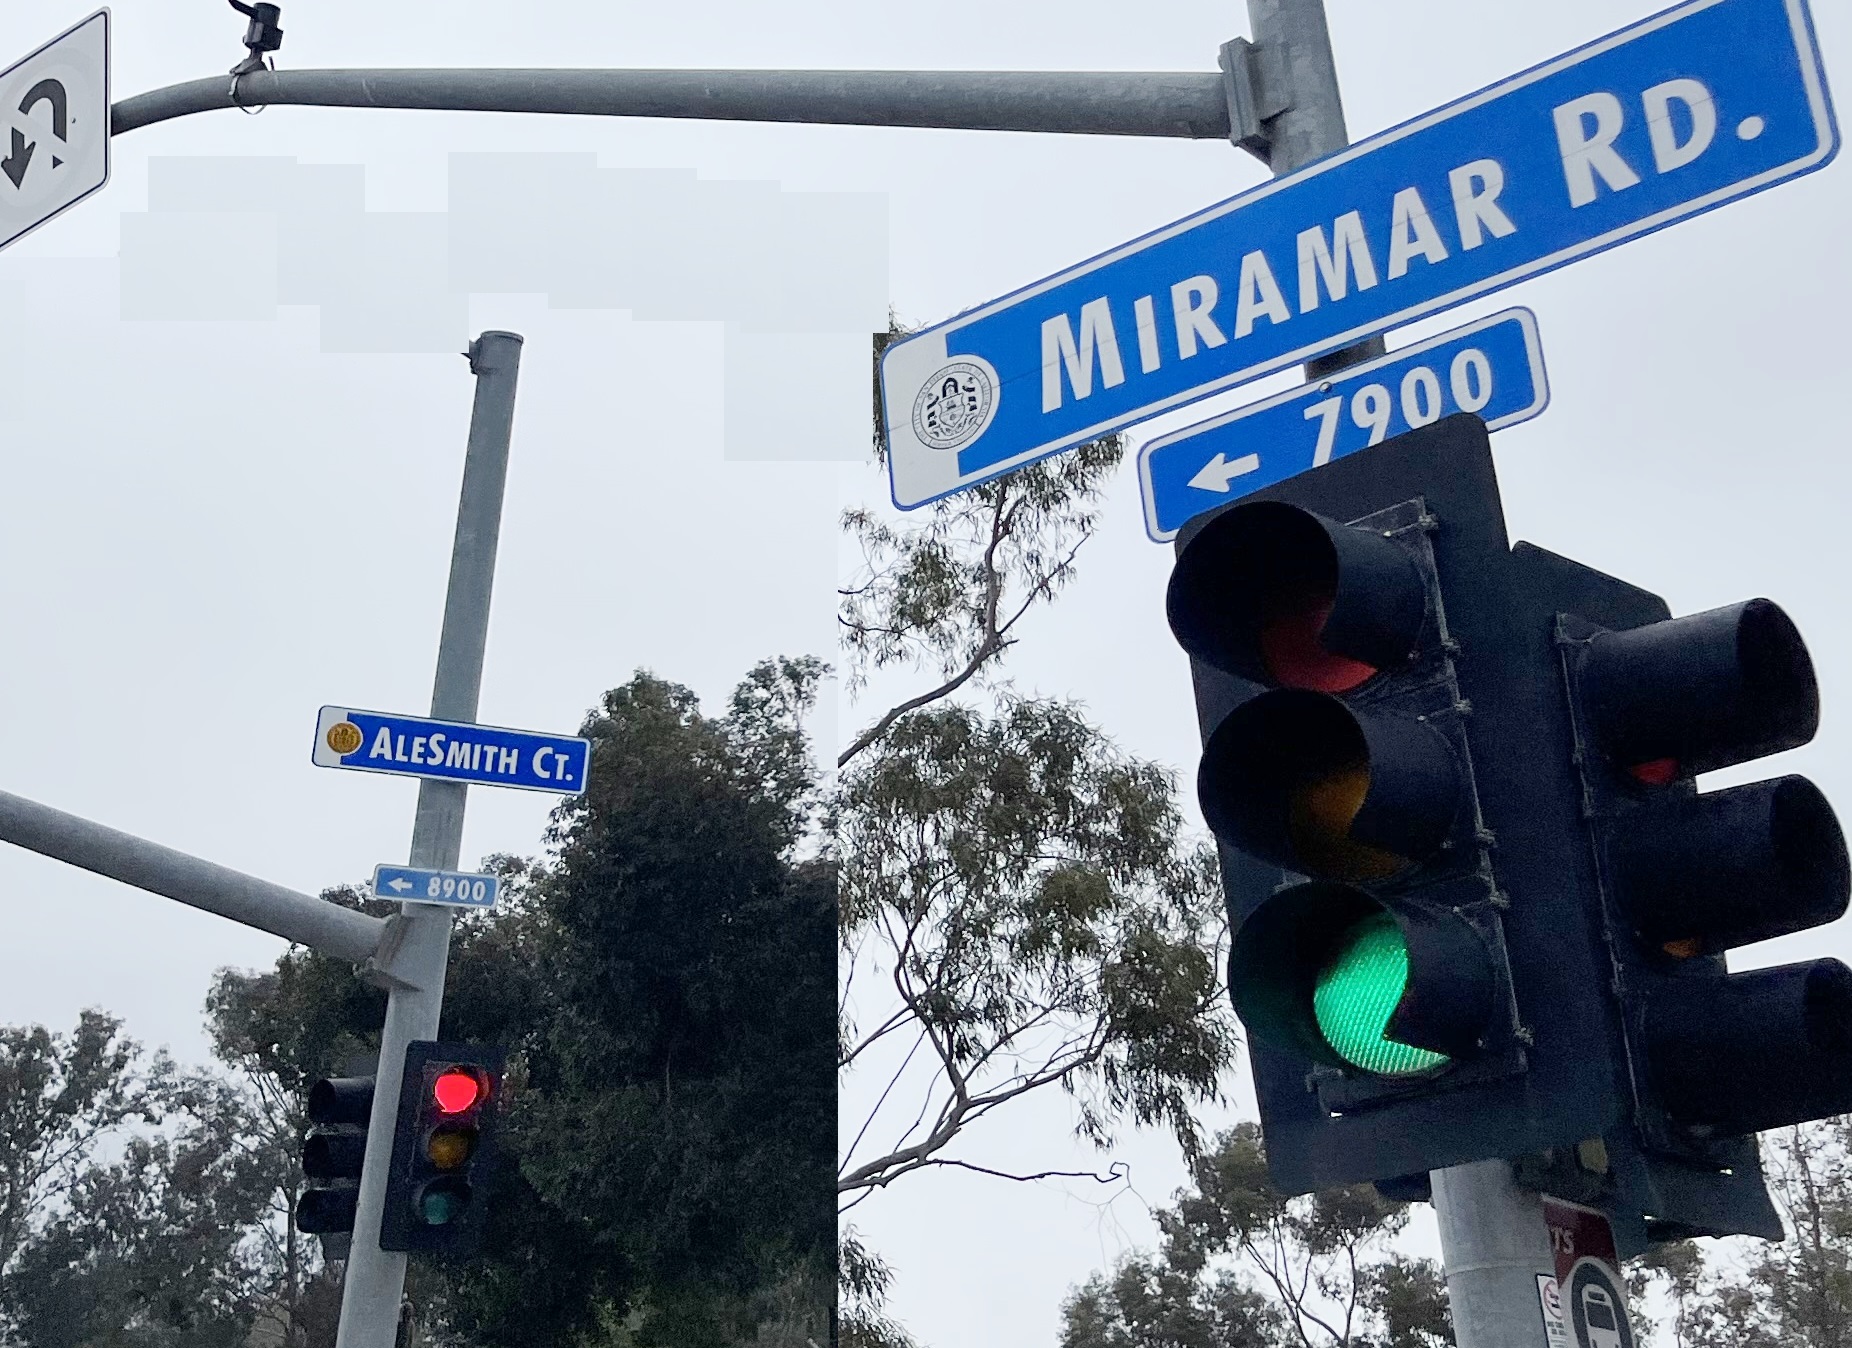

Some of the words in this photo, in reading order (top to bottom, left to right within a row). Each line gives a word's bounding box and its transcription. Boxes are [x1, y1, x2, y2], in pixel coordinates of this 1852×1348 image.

[1041, 158, 1517, 414] MIRAMAR
[1553, 78, 1765, 208] RD.
[1304, 348, 1492, 468] 7900
[369, 726, 519, 776] ALESMITH
[532, 747, 574, 781] CT.
[427, 876, 487, 902] 8900
[1550, 1226, 1575, 1254] TS
